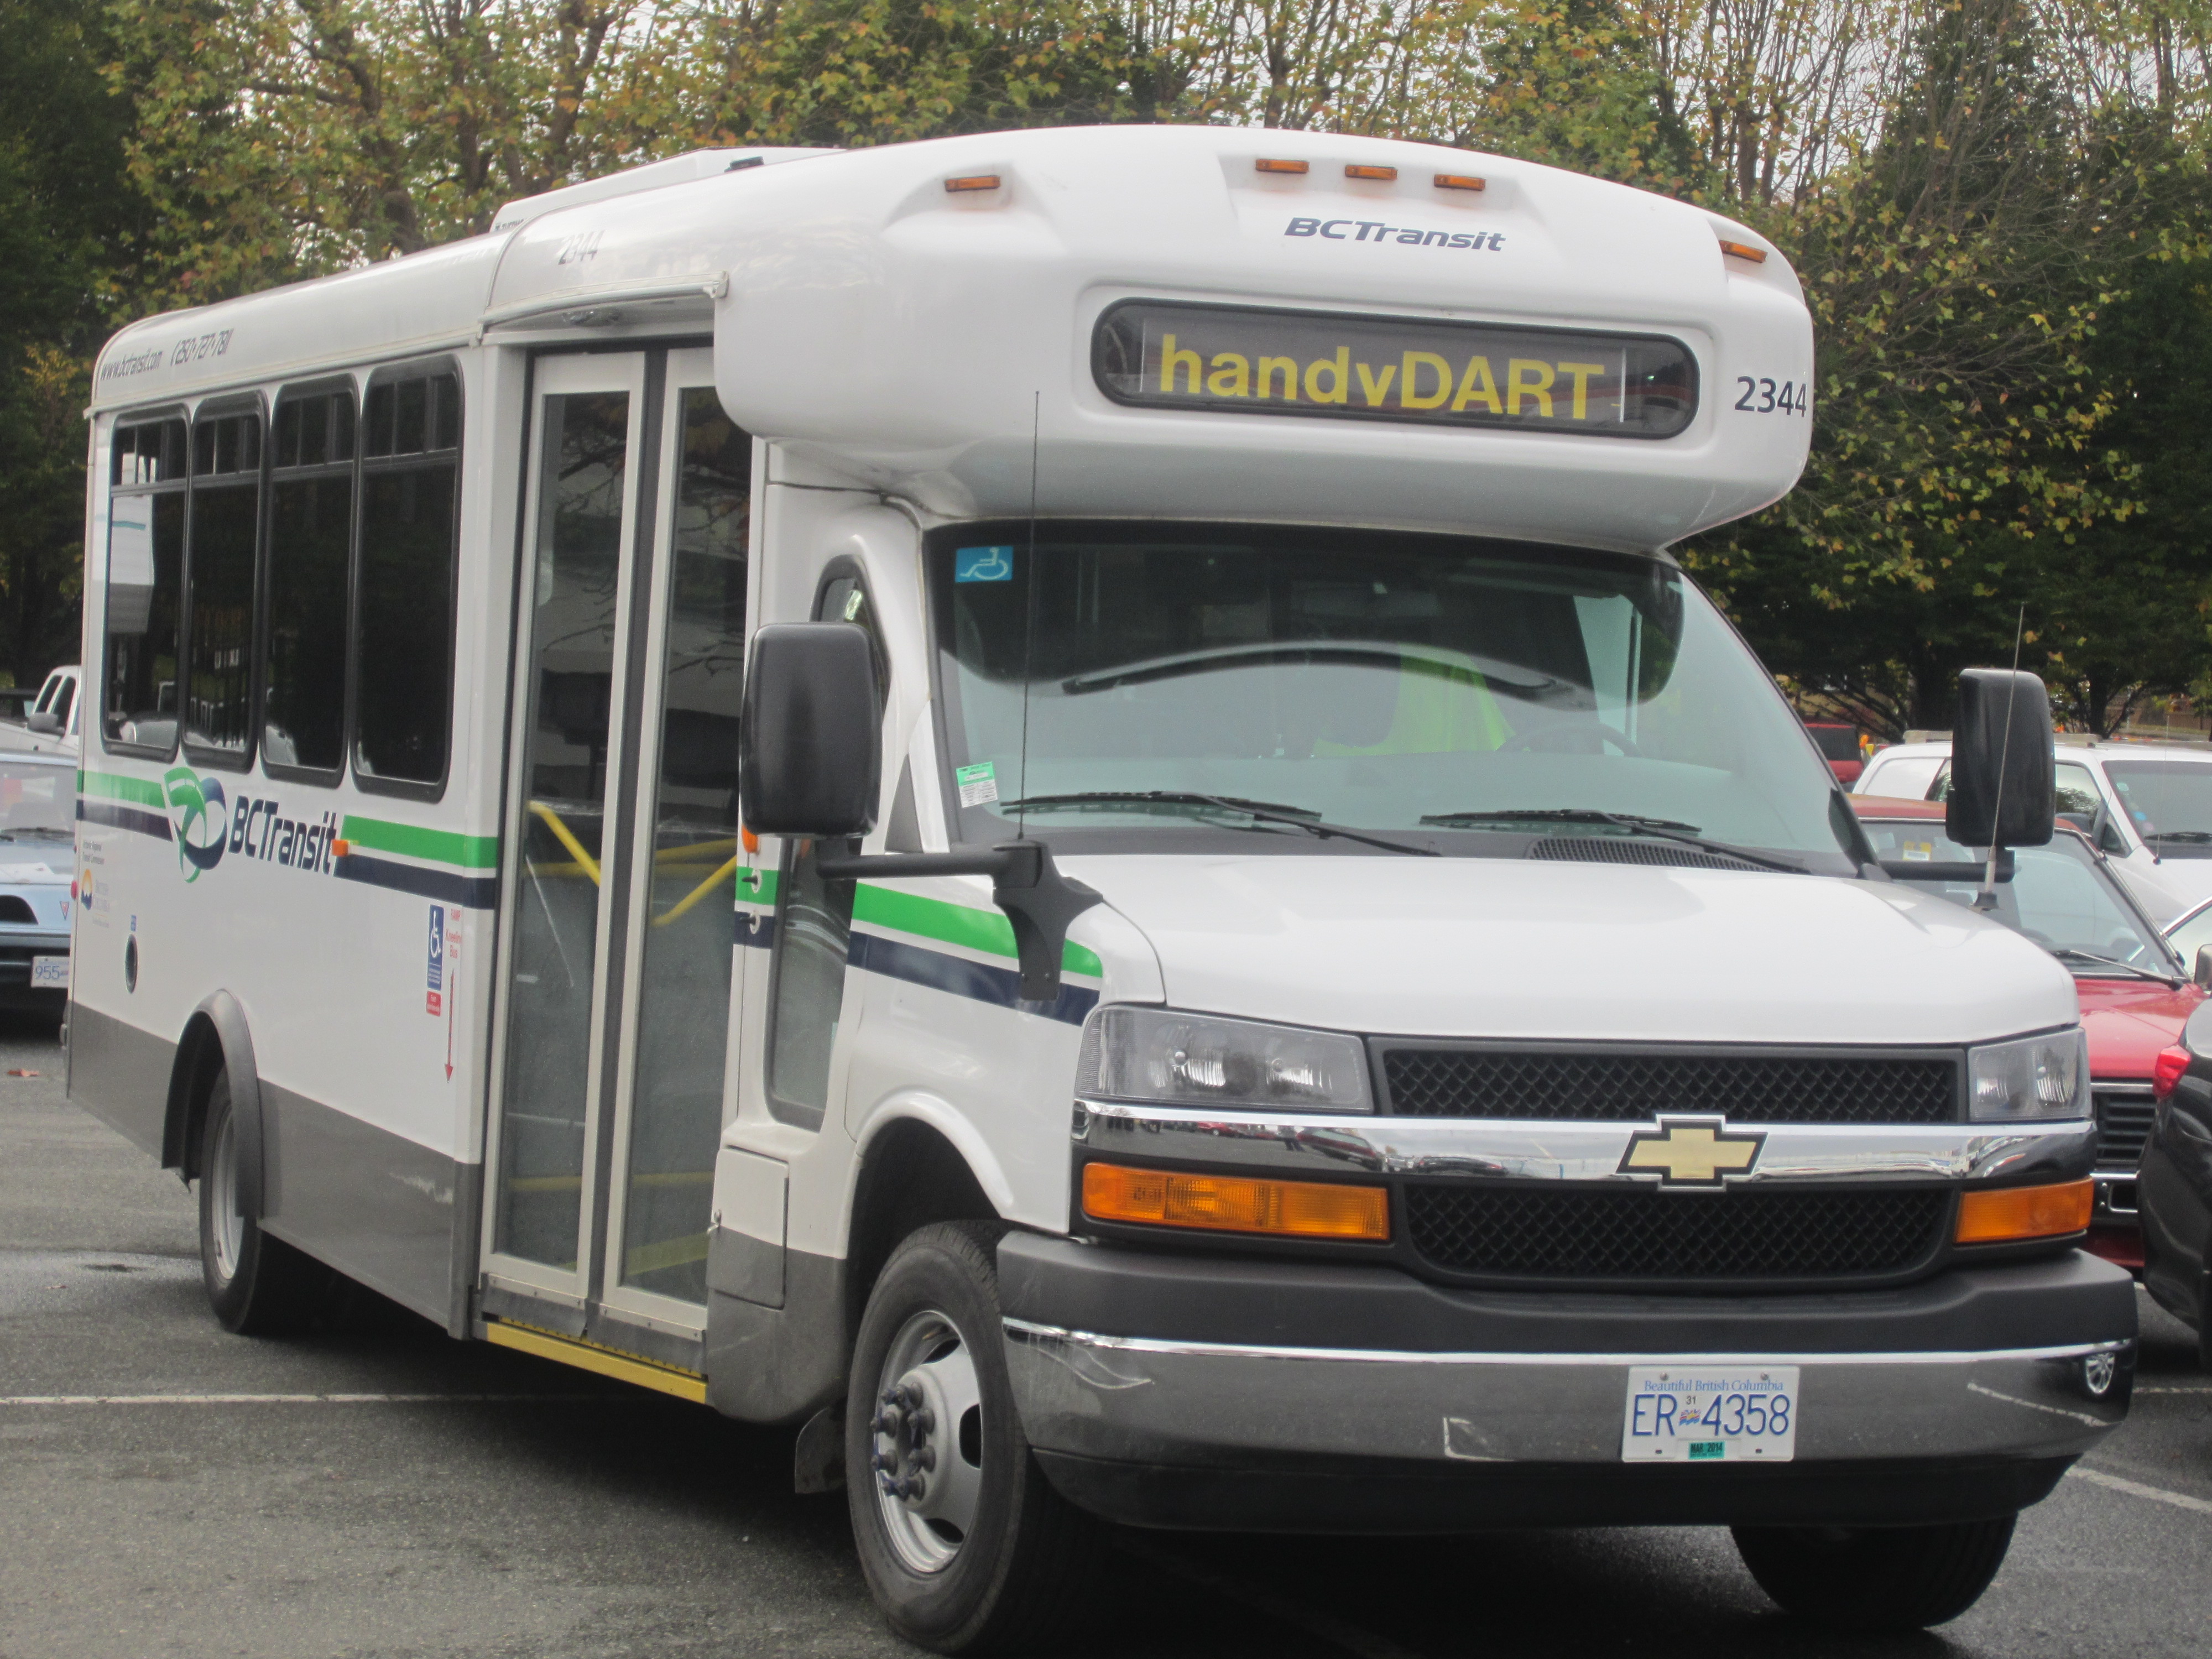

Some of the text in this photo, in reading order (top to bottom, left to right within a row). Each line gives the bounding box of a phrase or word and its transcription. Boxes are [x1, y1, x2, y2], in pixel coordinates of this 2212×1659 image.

[557, 229, 606, 265] 2344
[1284, 217, 1506, 252] BCTransit
[1734, 375, 1807, 418] 2344
[228, 795, 337, 875] BCTransit
[1644, 1379, 1783, 1392] Beautiful British Columbia
[1686, 1395, 1697, 1405] 31
[1632, 1393, 1790, 1436] ER 4358
